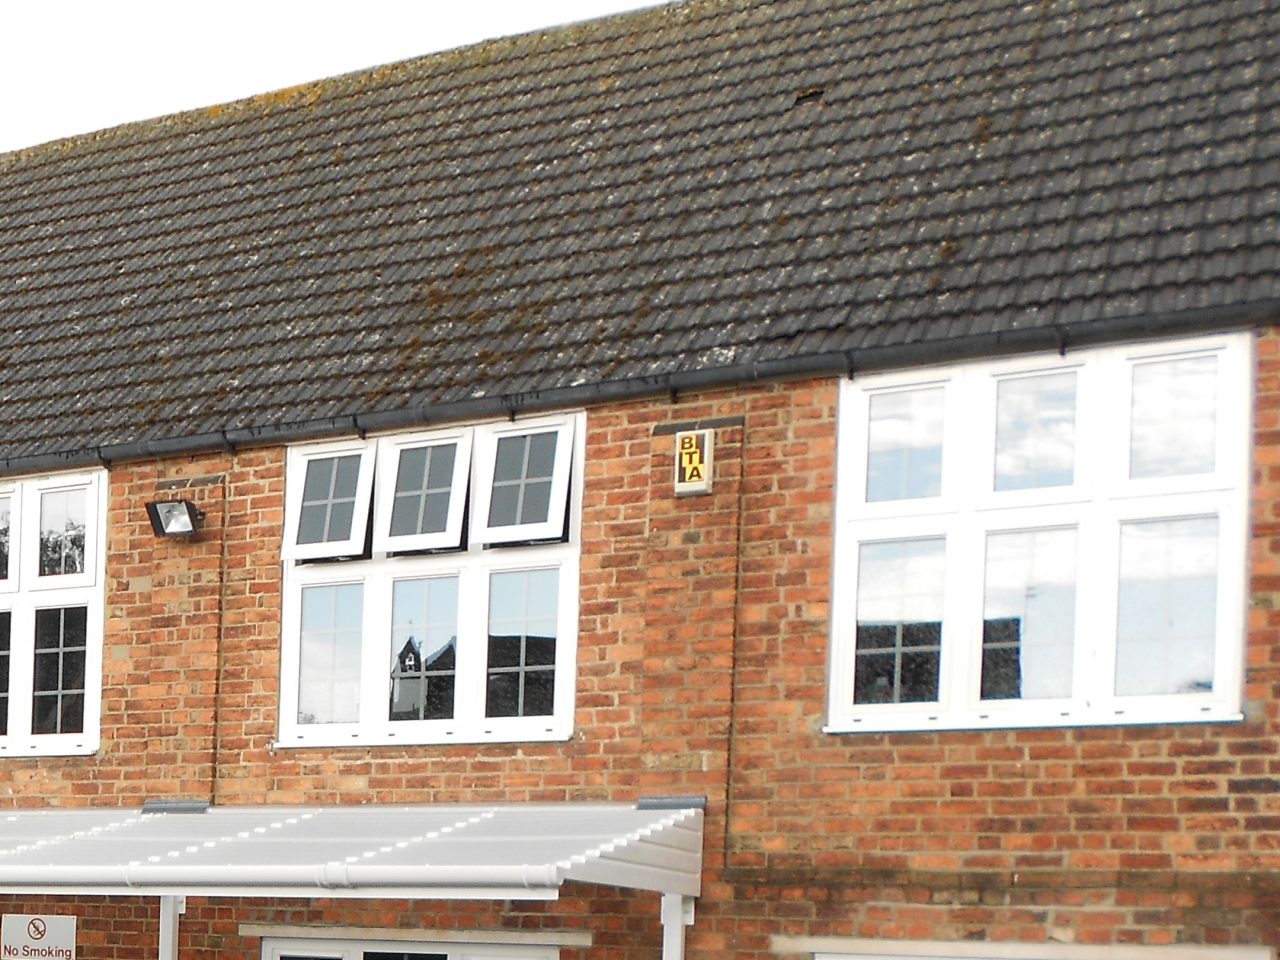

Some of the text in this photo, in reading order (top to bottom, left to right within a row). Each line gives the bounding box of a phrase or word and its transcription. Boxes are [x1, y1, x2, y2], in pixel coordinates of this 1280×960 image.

[681, 436, 702, 480] BTA
[3, 945, 72, 960] No Smoking
